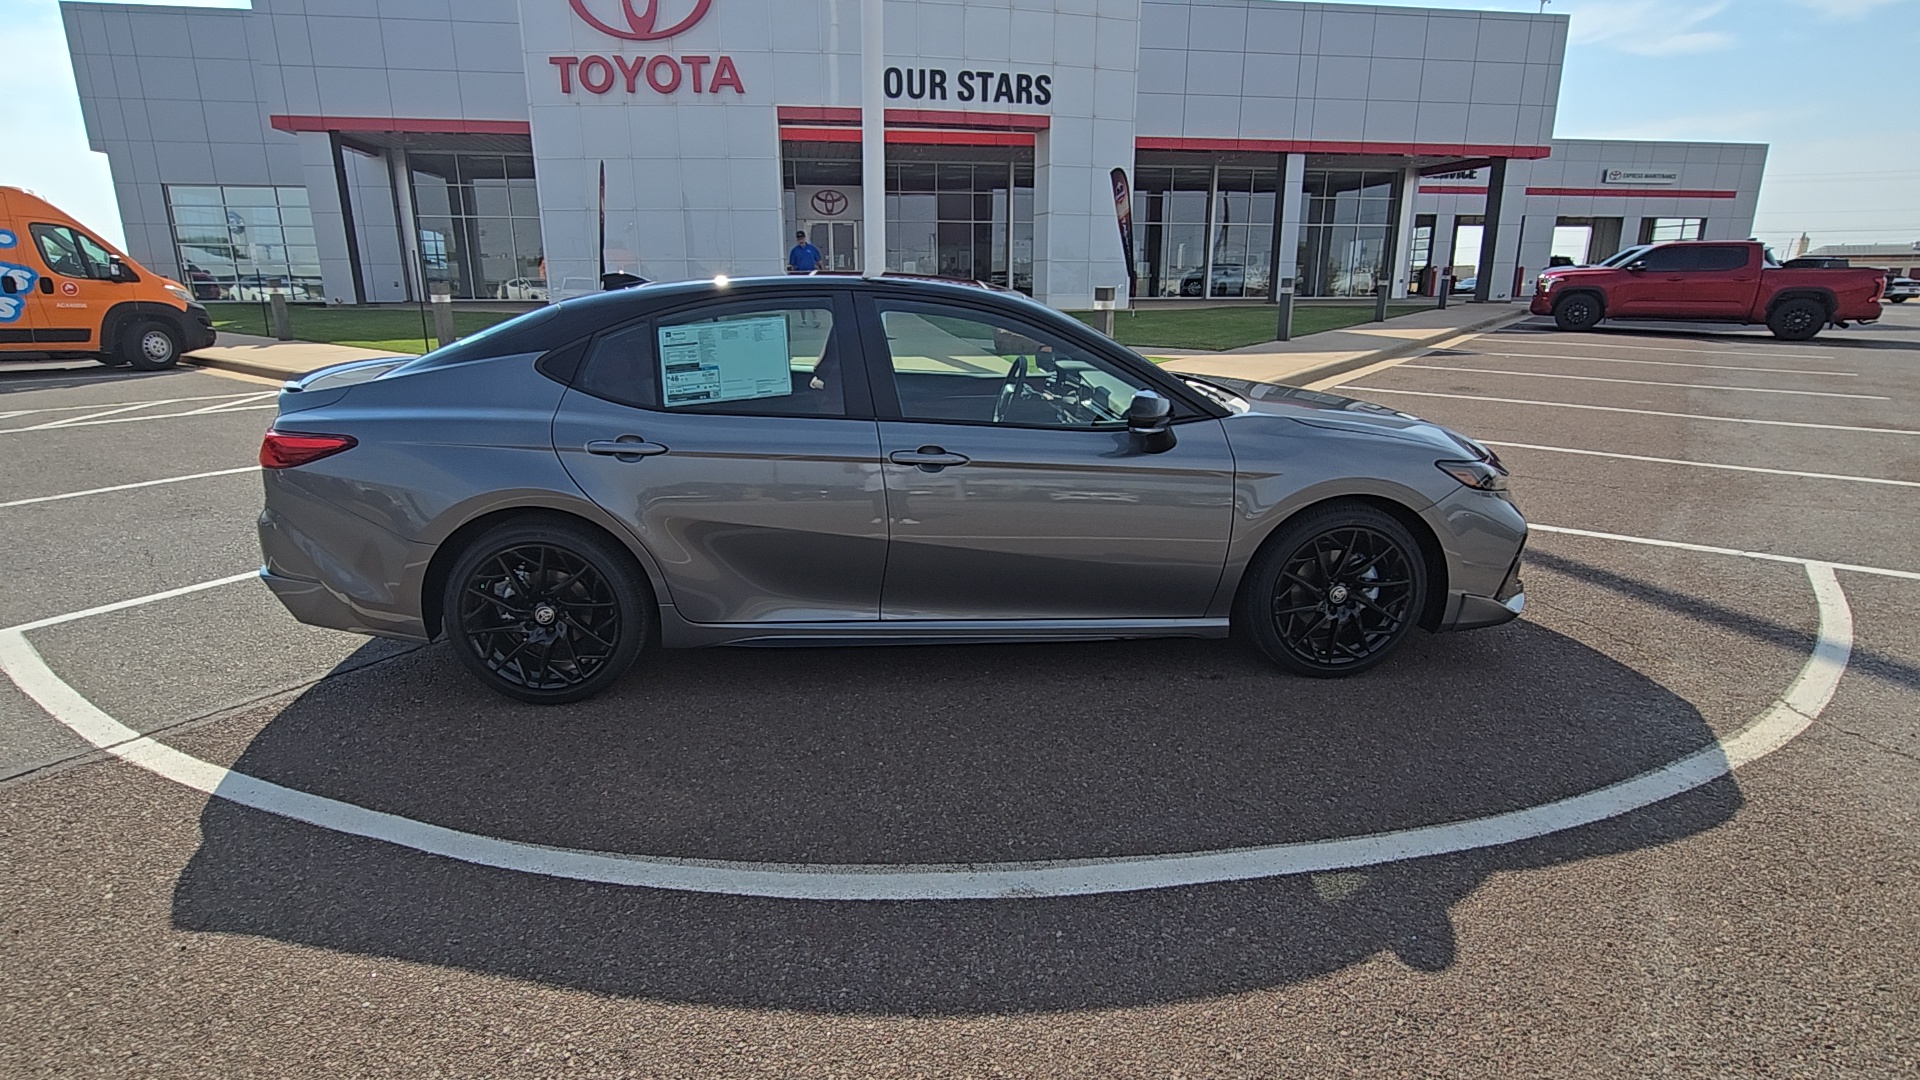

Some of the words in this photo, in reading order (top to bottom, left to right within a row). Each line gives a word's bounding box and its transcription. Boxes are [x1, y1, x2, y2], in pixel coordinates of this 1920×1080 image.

[549, 54, 745, 94] TOYOTA
[884, 67, 947, 101] OUR
[957, 71, 1052, 105] STARS
